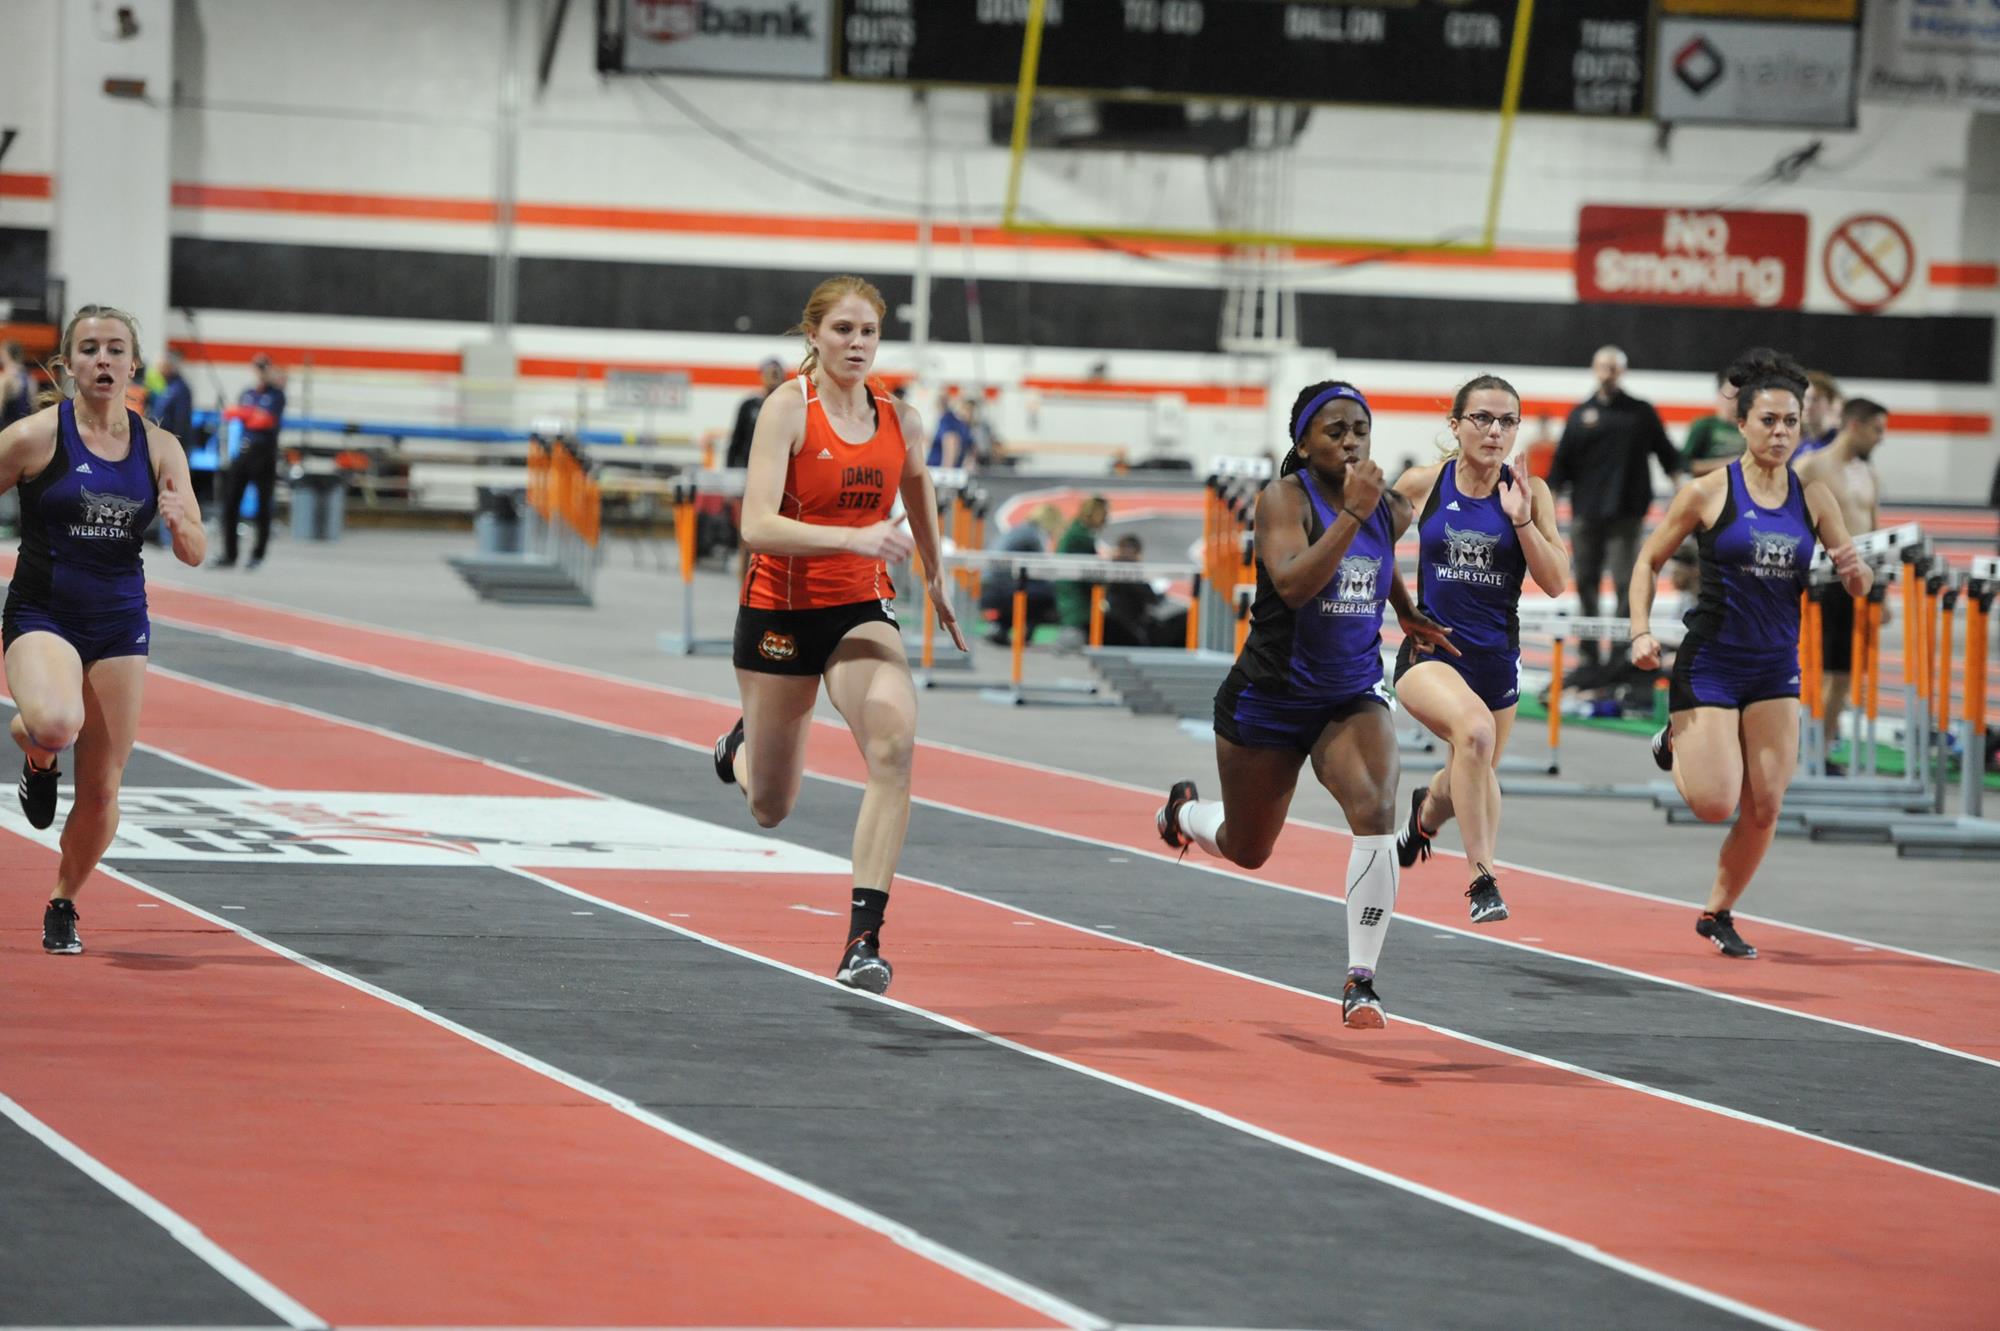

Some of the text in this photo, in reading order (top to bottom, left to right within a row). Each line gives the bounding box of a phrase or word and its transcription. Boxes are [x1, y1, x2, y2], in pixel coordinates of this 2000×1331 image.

[847, 14, 916, 44] OUTS
[1284, 5, 1386, 43] BALL ON
[1579, 19, 1639, 48] TIME
[847, 46, 910, 77] LEFT
[1572, 50, 1641, 82] OUTS
[1573, 83, 1638, 113] LEFT
[1663, 209, 1729, 255] NO
[841, 466, 883, 488] IDAHO
[838, 491, 882, 511] STATE
[69, 525, 108, 537] WEBER
[1436, 566, 1502, 586] WEBER STATE
[1322, 600, 1376, 614] WEBER STATE
